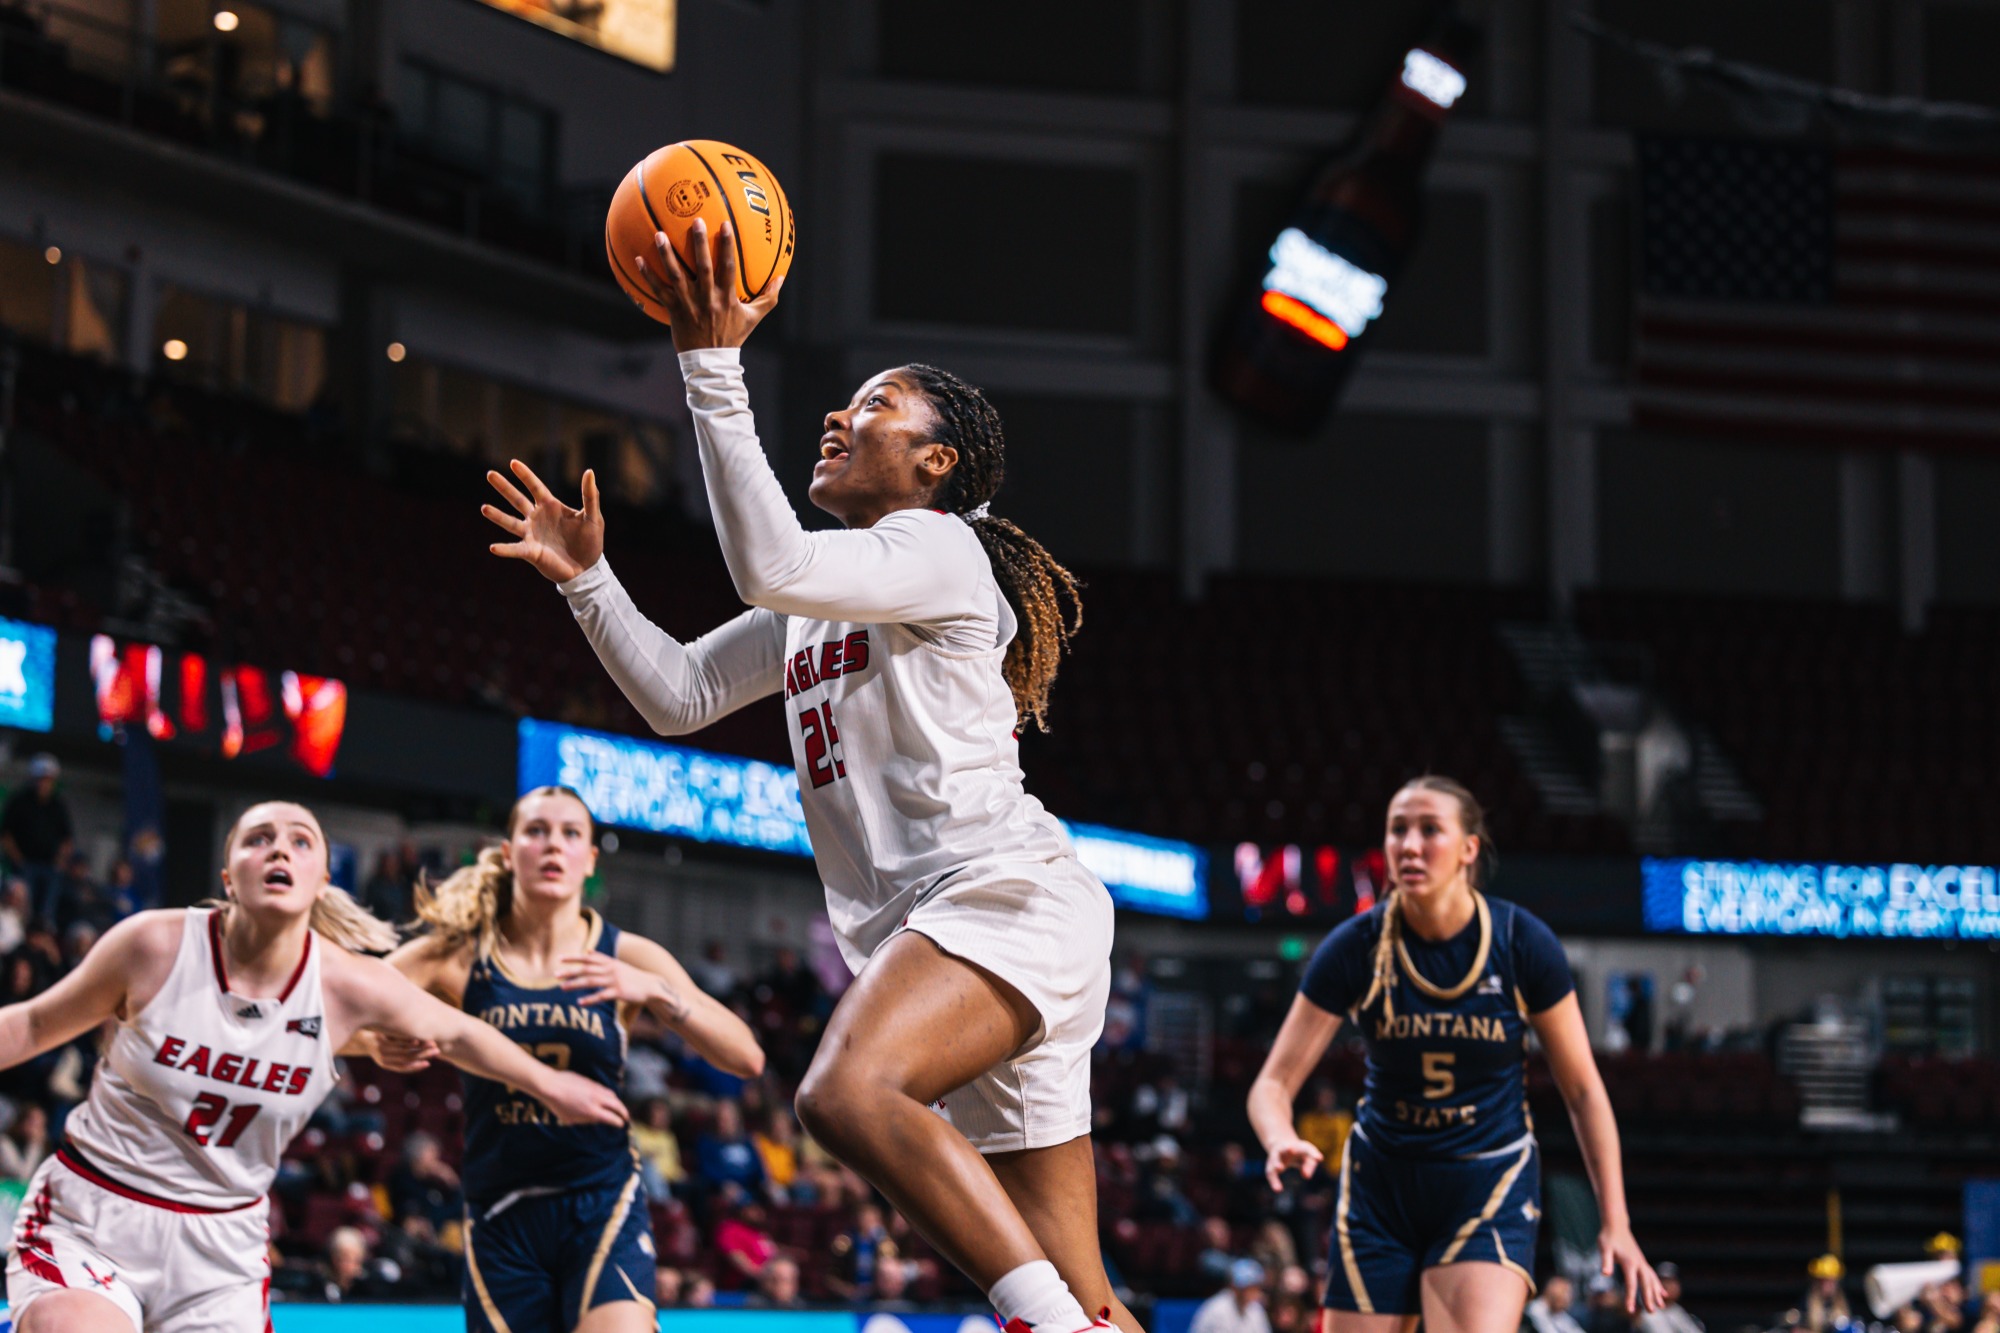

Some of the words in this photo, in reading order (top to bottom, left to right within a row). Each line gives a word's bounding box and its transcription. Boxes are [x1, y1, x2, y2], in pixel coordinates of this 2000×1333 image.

[721, 153, 771, 216] EVO
[764, 217, 772, 245] NXT
[785, 630, 869, 701] AGLES
[153, 1035, 312, 1095] EAGLES
[1421, 1053, 1456, 1099] 5
[184, 1092, 262, 1147] 21
[1395, 1101, 1477, 1128] STATE
